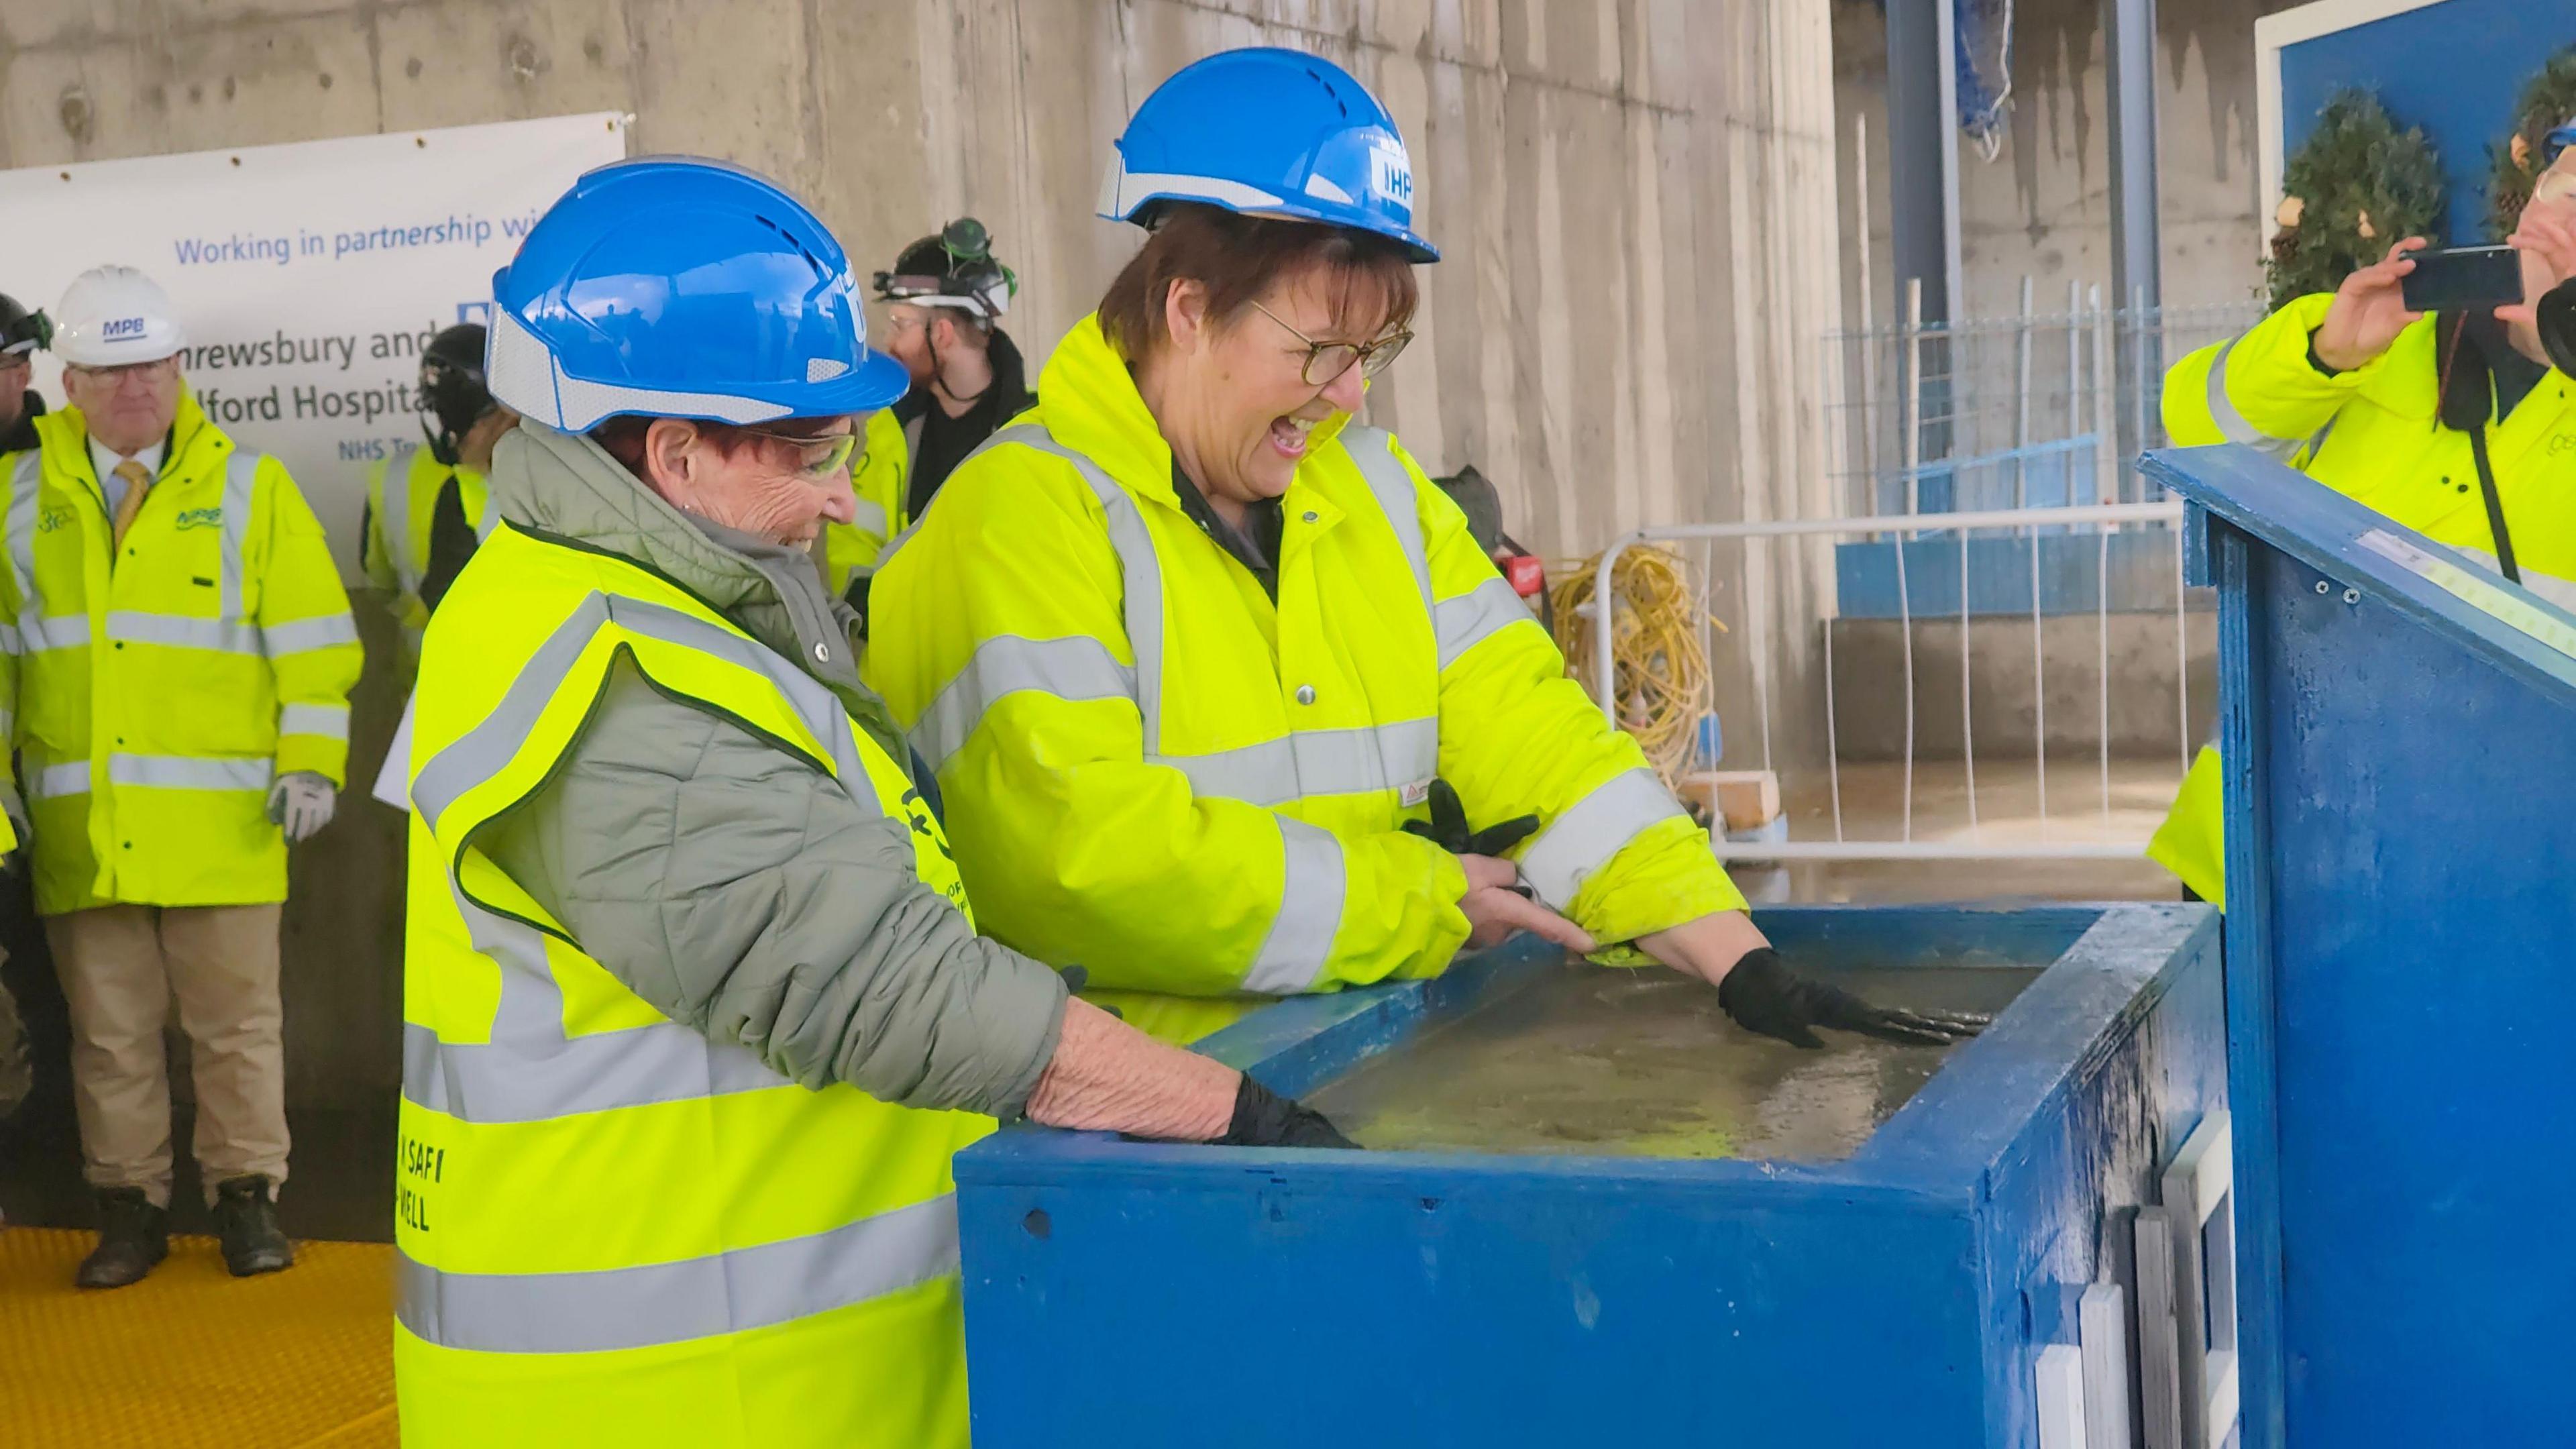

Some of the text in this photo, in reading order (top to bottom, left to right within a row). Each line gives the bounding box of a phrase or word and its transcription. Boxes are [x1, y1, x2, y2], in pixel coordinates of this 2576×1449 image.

[1384, 161, 1412, 200] IHP
[175, 209, 543, 266] Working in partnership wi
[103, 317, 144, 336] MPB
[197, 384, 281, 423] lford
[338, 438, 384, 460] NHS
